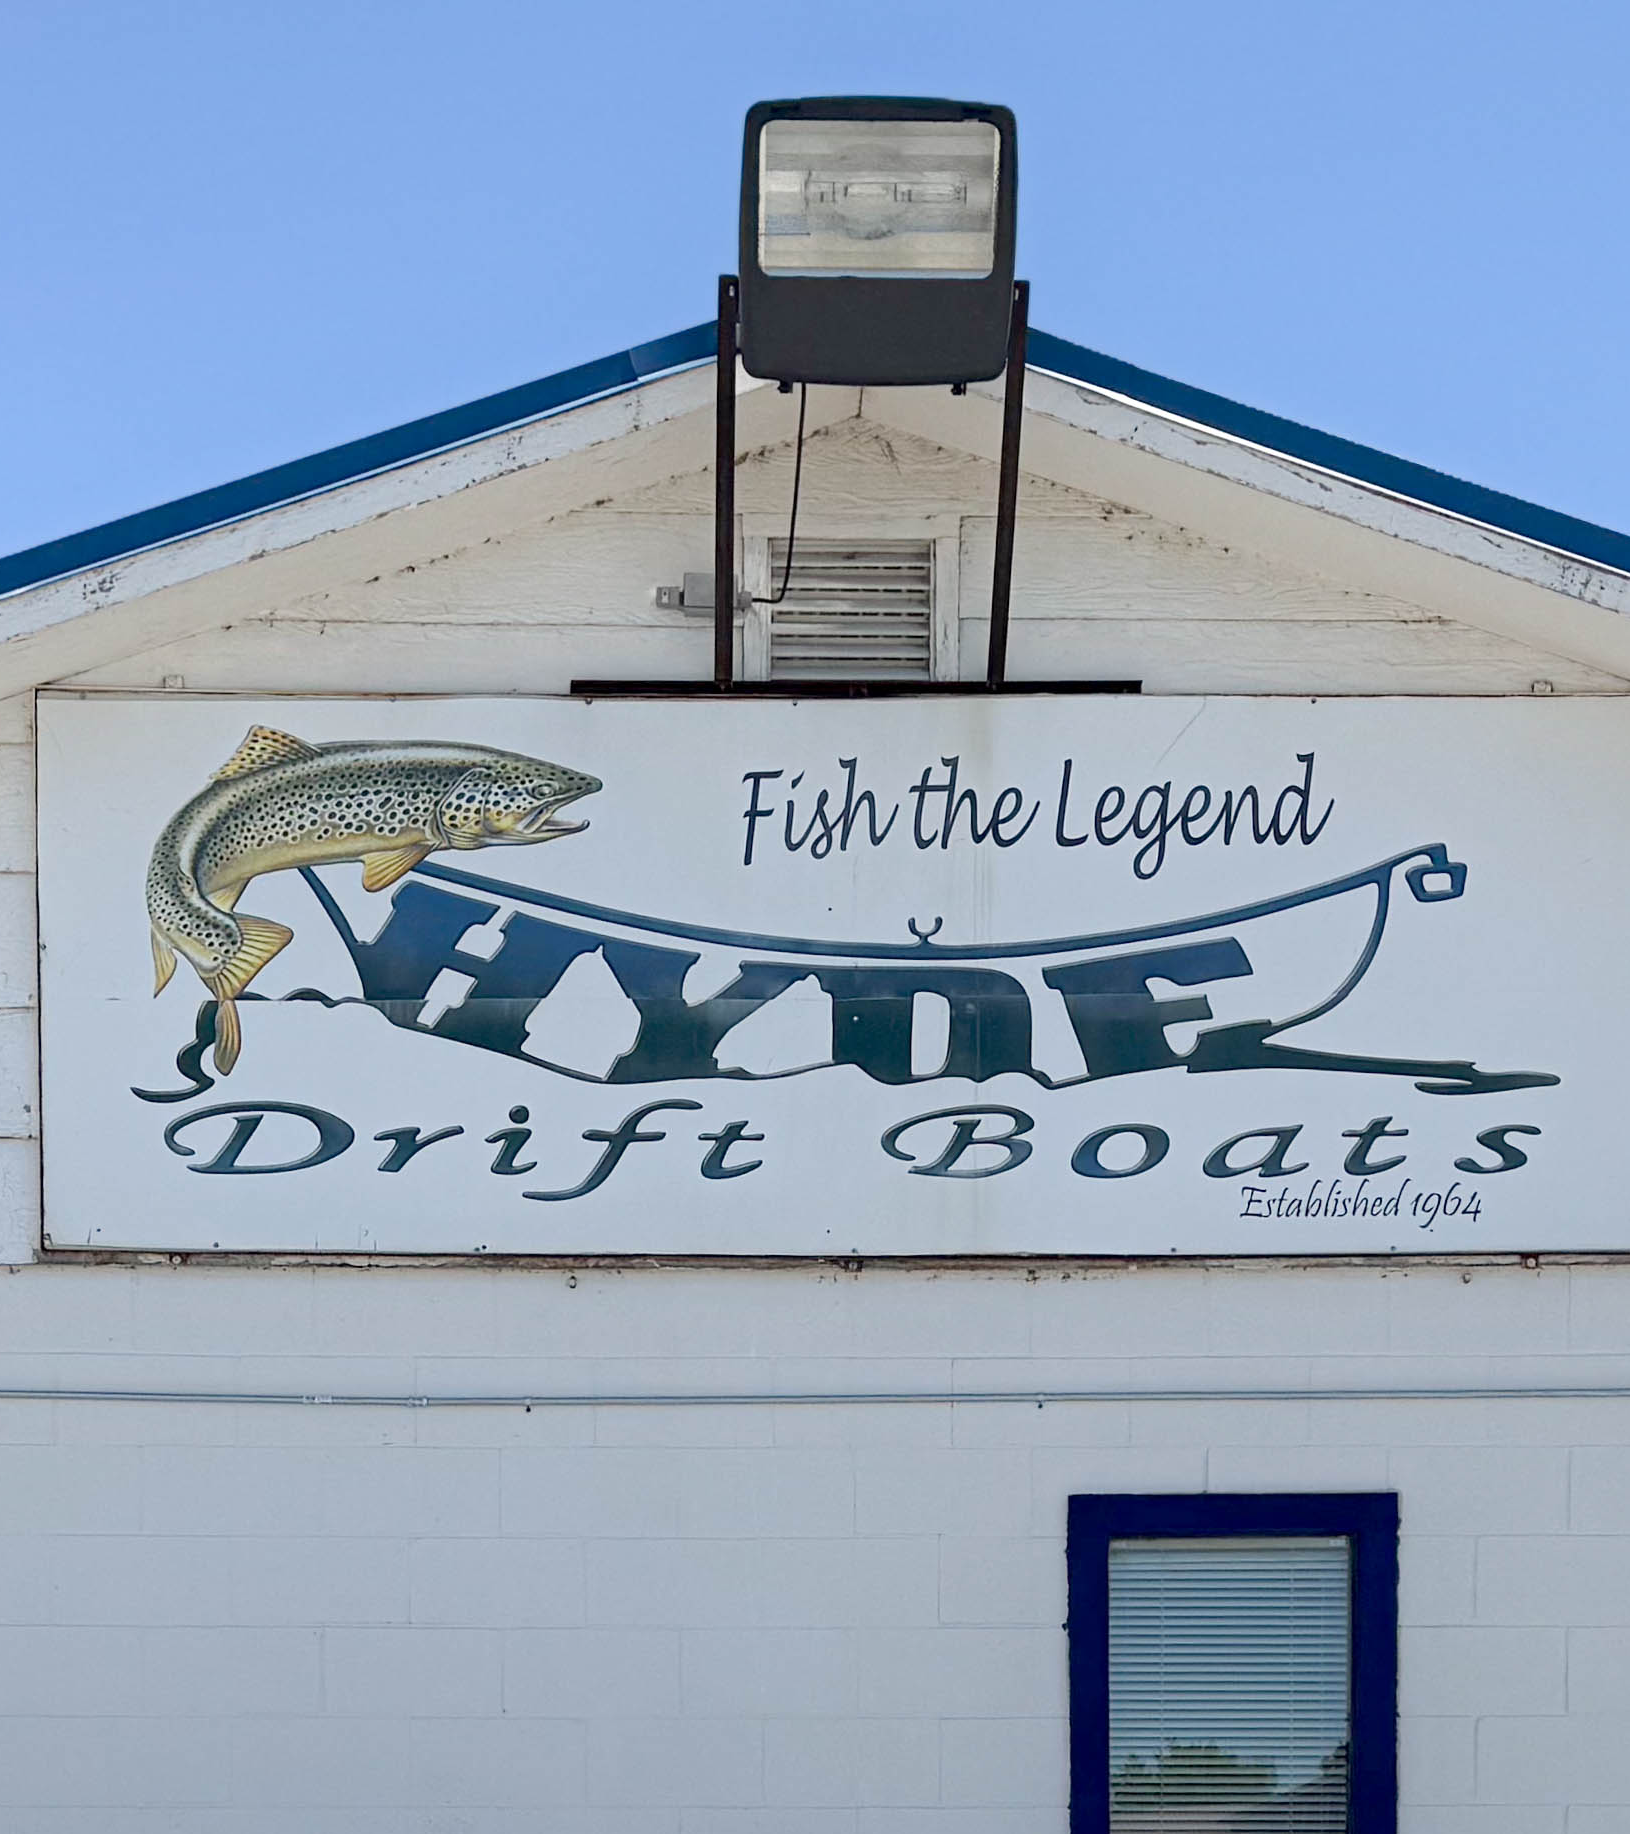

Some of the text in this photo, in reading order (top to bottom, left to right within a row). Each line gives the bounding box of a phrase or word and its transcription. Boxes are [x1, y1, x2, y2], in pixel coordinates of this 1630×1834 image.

[741, 752, 1336, 881] Fish the Legend
[361, 880, 1274, 1088] HYDE
[163, 1099, 1543, 1202] Drift Boats
[1239, 1178, 1482, 1229] Established 1964
